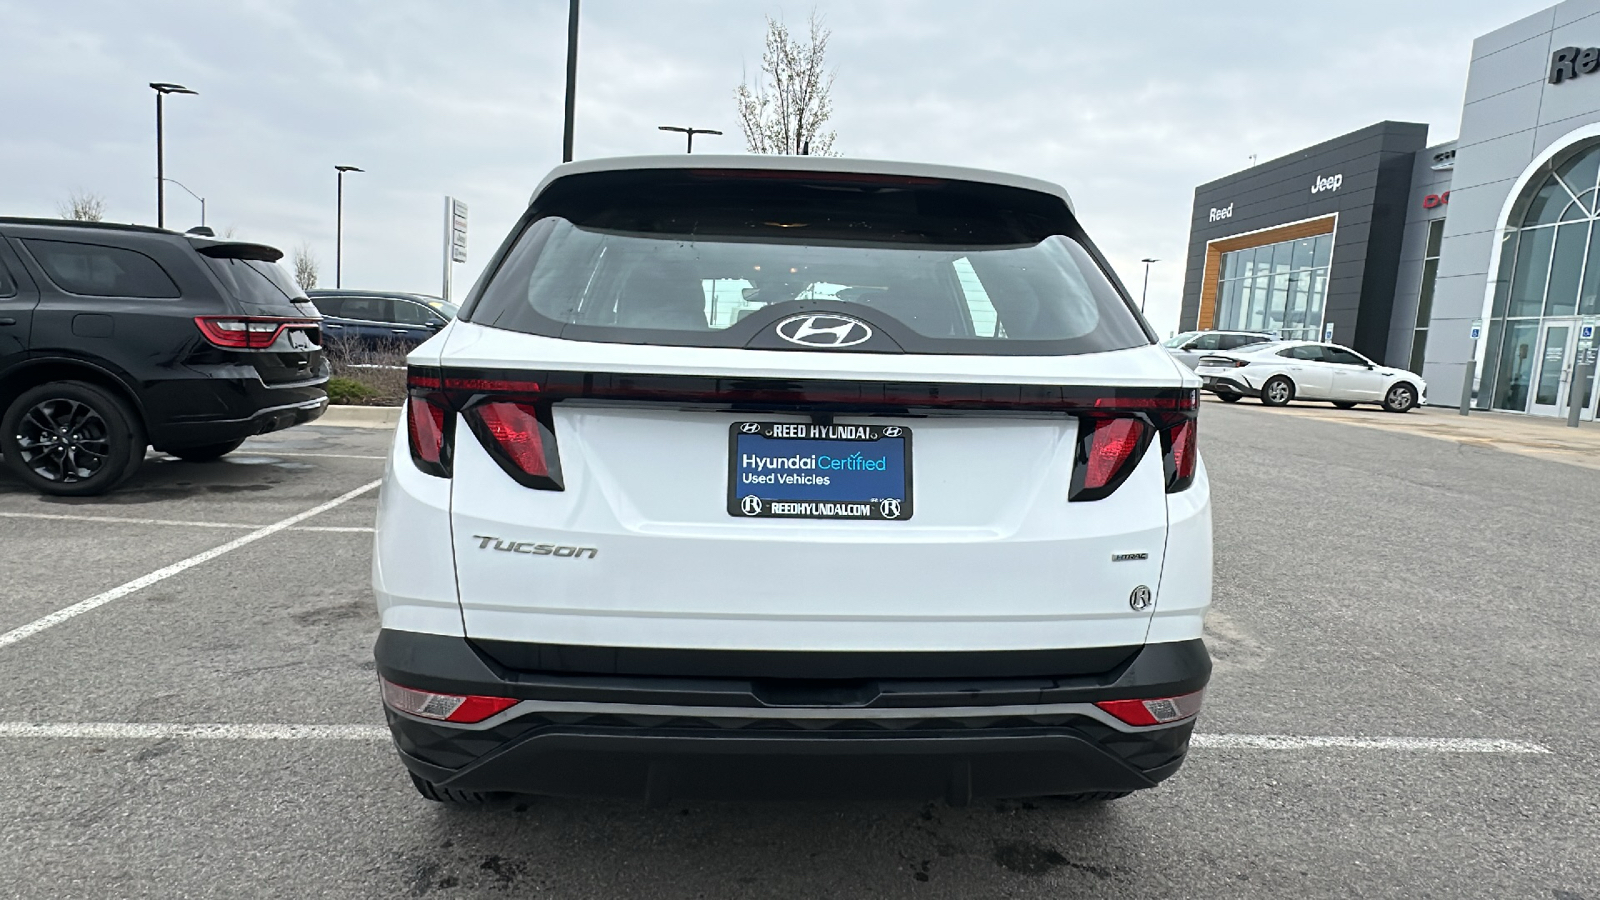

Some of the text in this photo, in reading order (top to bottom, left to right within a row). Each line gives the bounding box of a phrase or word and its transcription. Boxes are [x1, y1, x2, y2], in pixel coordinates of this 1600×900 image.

[1311, 173, 1342, 194] Jeep
[1209, 202, 1233, 223] Reed
[773, 424, 870, 440] REED HYUNDAI
[742, 452, 886, 471] Hyundai Certified
[742, 473, 831, 486] Used Vehicles
